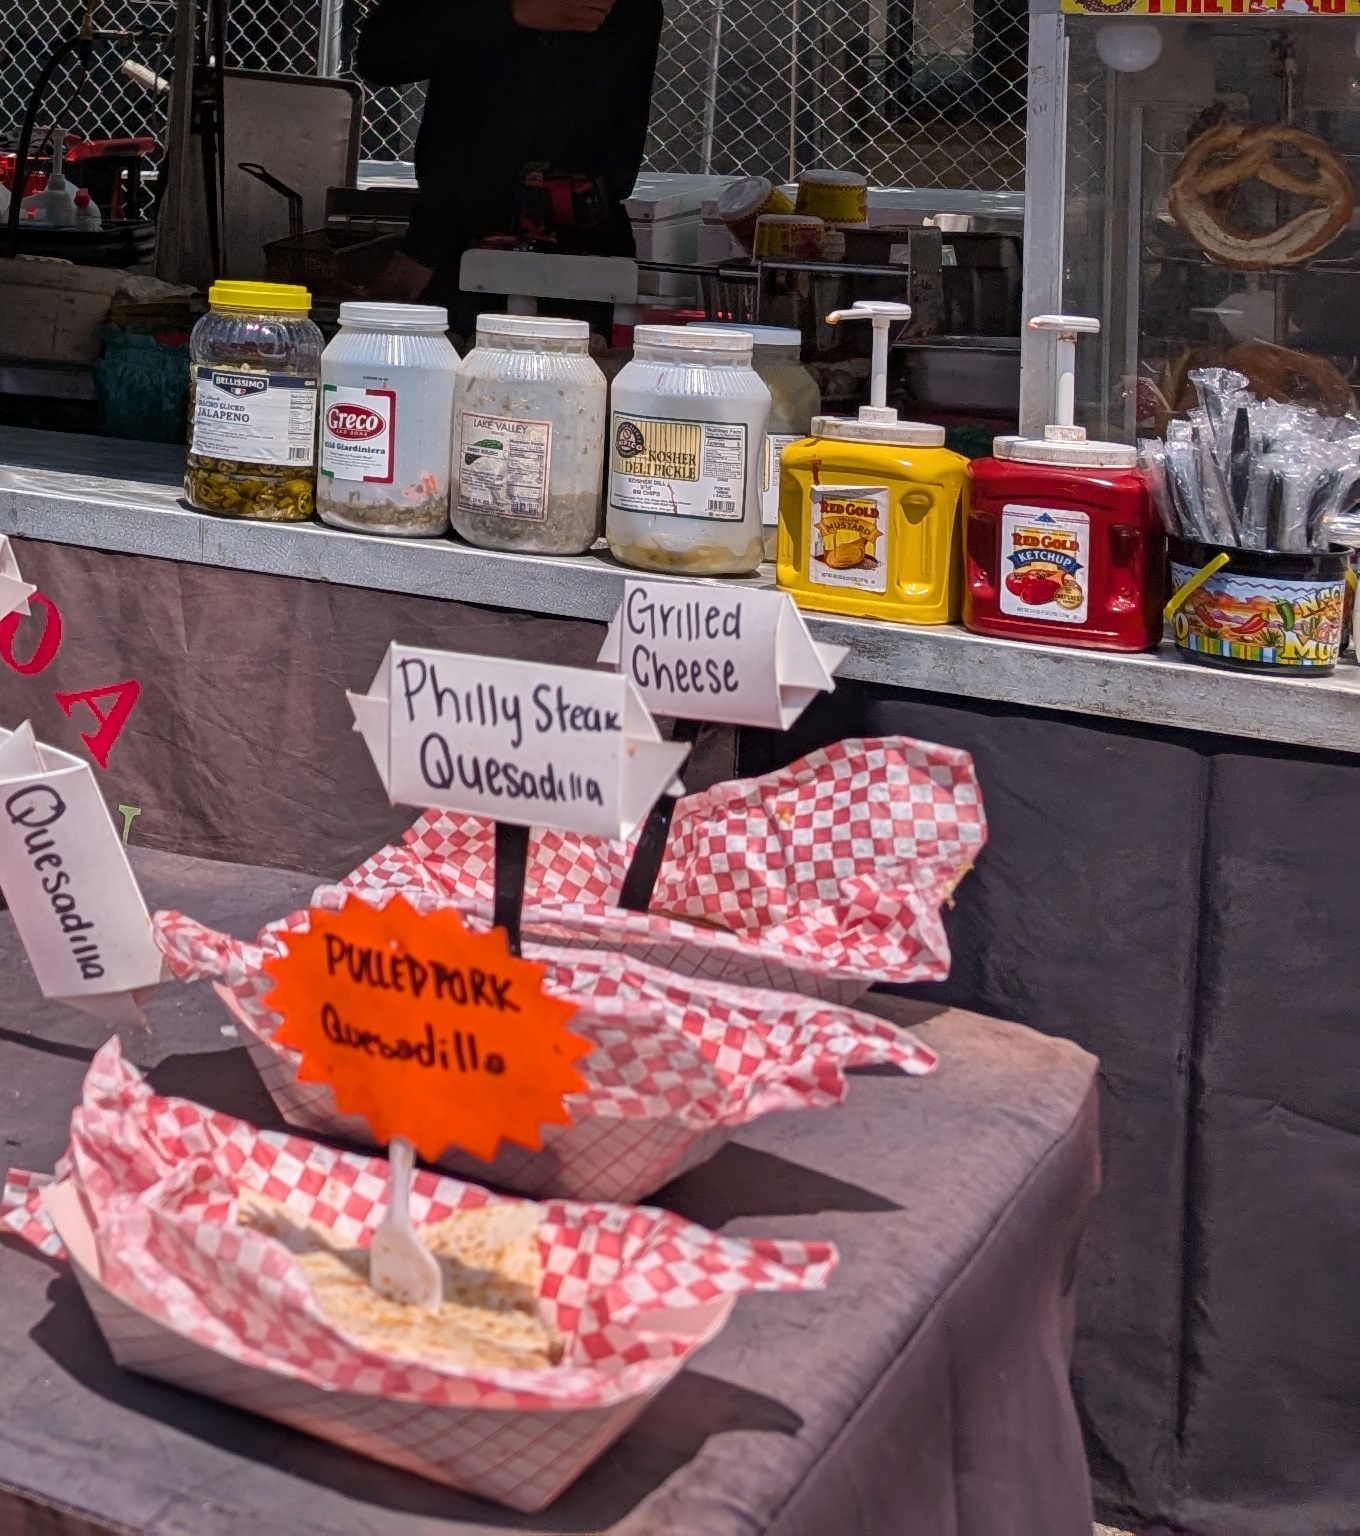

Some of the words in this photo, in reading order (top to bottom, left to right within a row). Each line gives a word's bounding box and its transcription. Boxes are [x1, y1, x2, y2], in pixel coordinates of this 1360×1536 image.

[215, 376, 264, 389] BELLISSIMO
[197, 408, 250, 423] JALAPENO
[328, 408, 378, 431] Greco
[473, 419, 492, 430] LAKE
[495, 422, 528, 434] VALLEY
[336, 443, 386, 454] Giardiniera
[648, 451, 696, 465] KOSHER
[625, 461, 651, 476] DELI
[653, 463, 696, 480] PICKLE
[821, 500, 844, 514] RED
[845, 503, 879, 518] GOLD
[826, 521, 871, 535] MUSTARD
[1012, 533, 1040, 546] RED
[1041, 535, 1079, 551] GOLD
[1018, 551, 1072, 567] KETCHUP
[626, 587, 742, 642] Grilled
[631, 645, 739, 694] Cheese
[398, 656, 523, 747] Philly
[533, 682, 623, 734] Steak
[419, 731, 603, 806] Quesadilla
[5, 783, 106, 982] Quesadilla
[320, 1003, 508, 1076] Quesadilla
